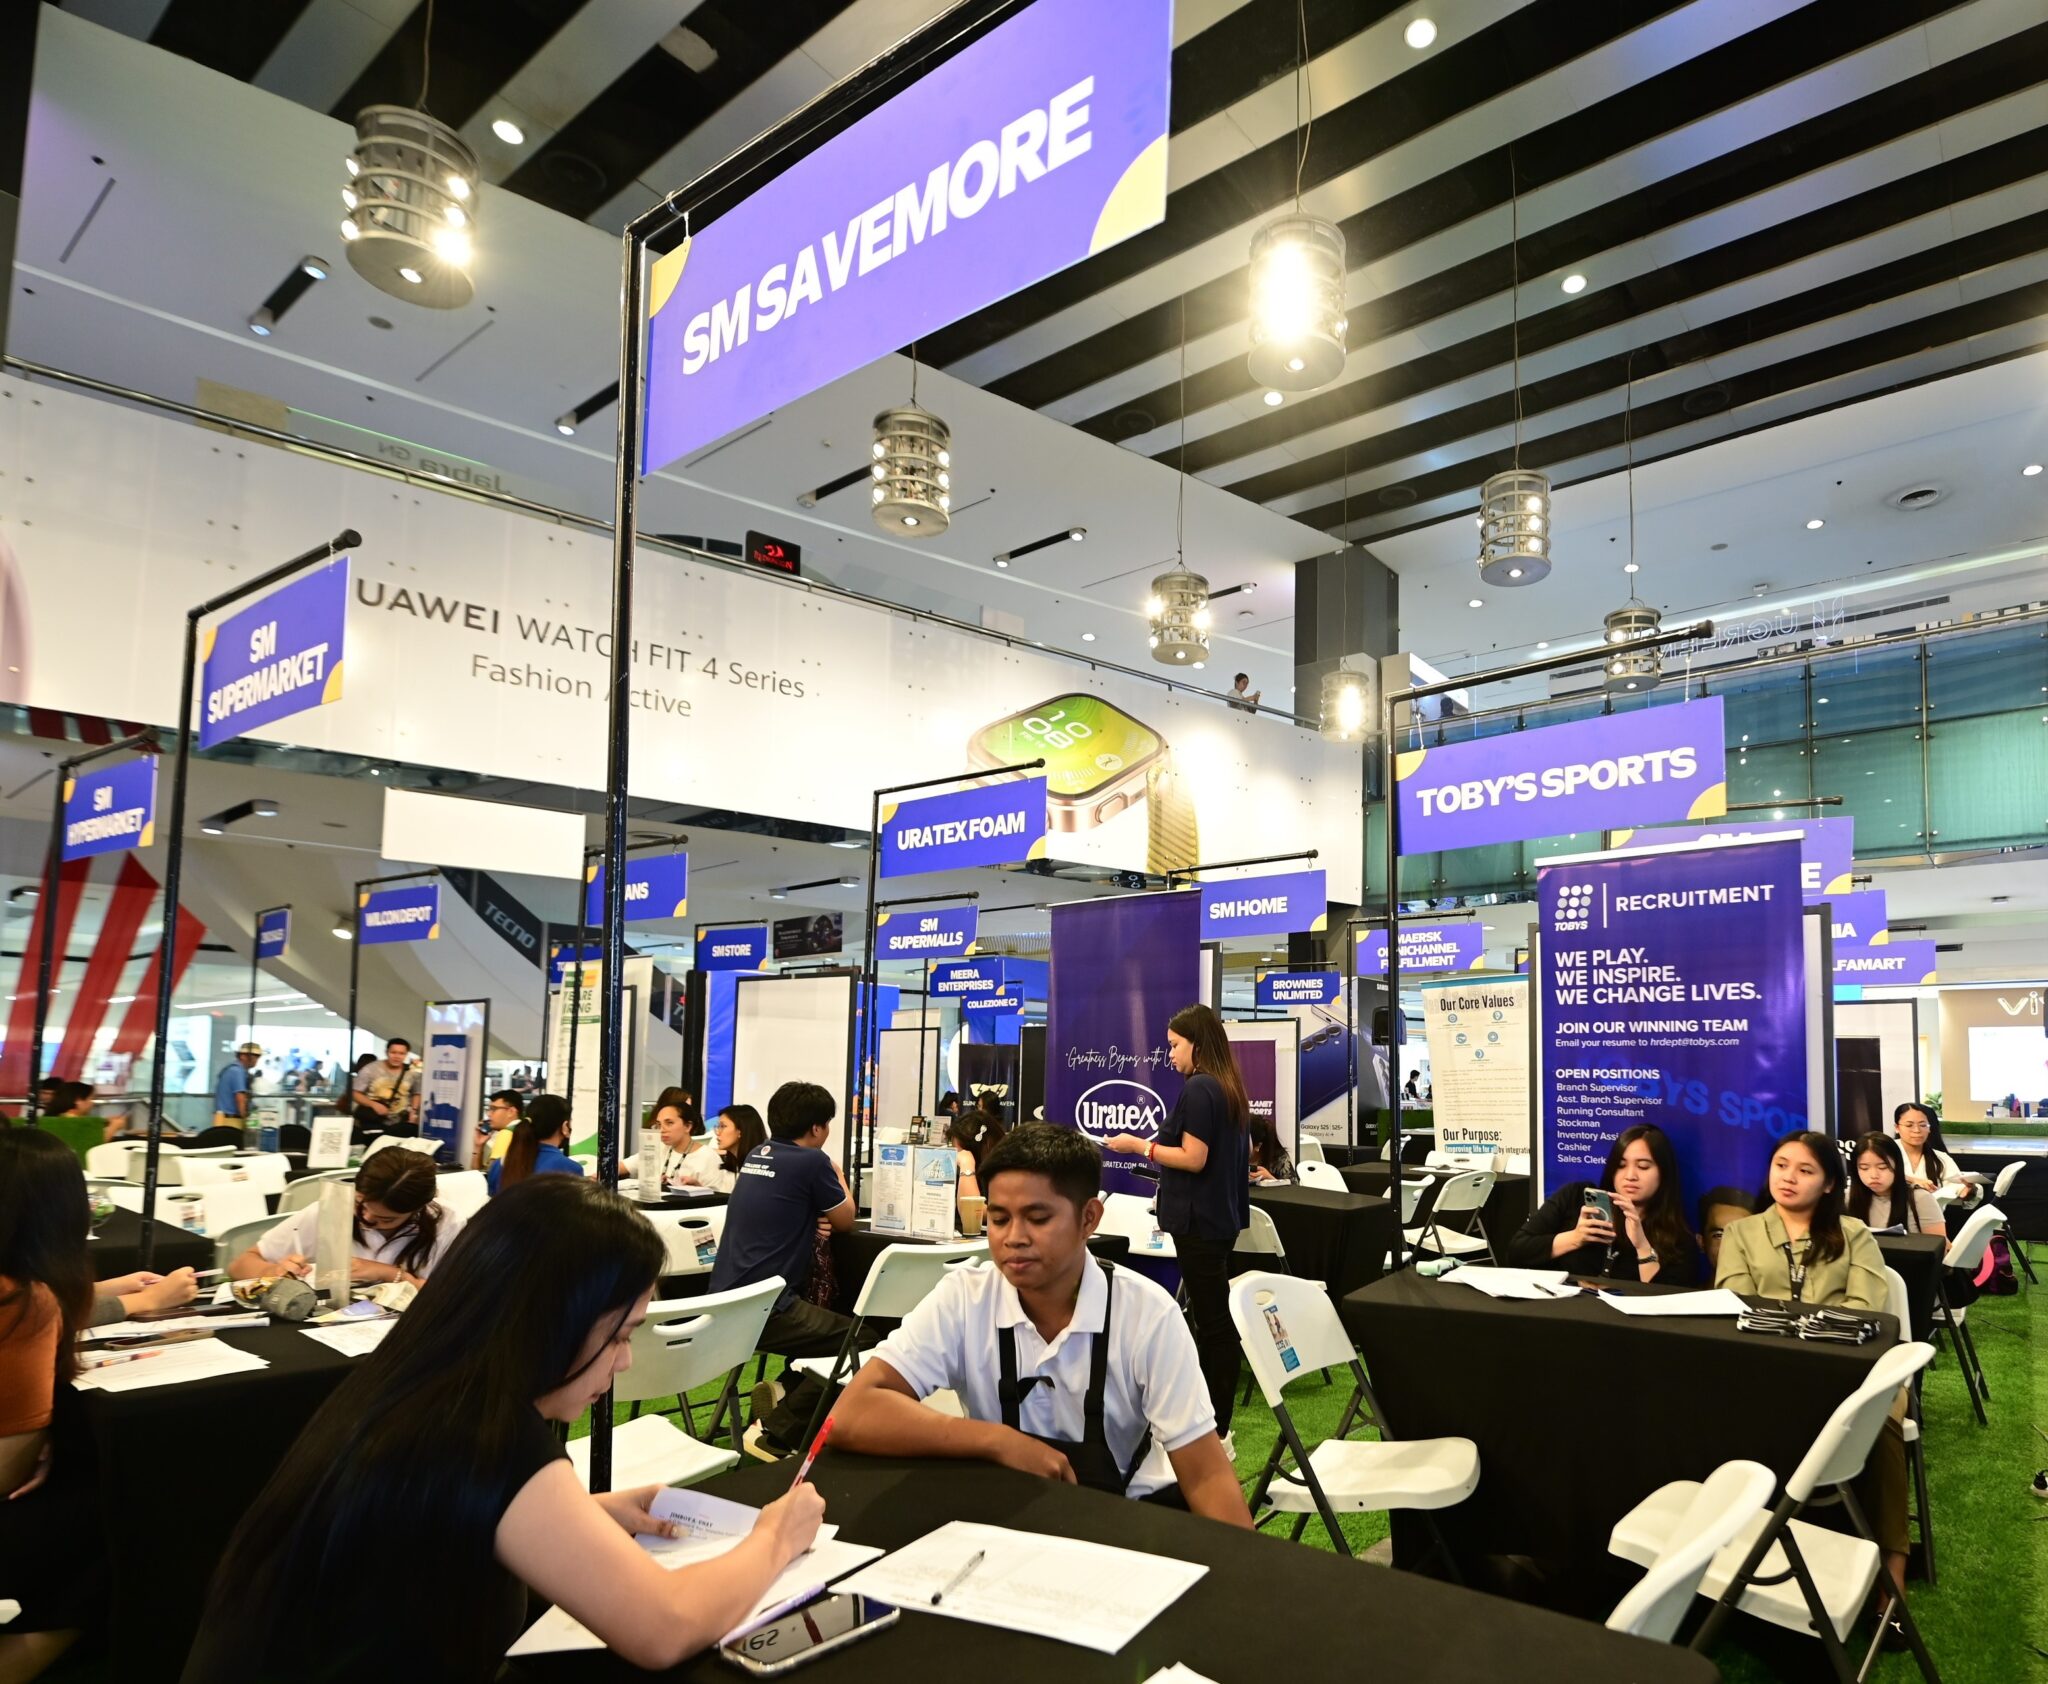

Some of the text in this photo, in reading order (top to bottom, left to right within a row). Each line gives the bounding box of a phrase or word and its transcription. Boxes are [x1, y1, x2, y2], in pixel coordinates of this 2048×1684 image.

[682, 75, 1095, 375] SM SAVEMORE
[250, 621, 277, 663] SM
[355, 577, 500, 635] UAWEI
[648, 643, 692, 673] FIT
[701, 656, 719, 680] 4
[729, 661, 805, 699] Series
[208, 642, 328, 724] SUPERMARKET
[471, 653, 592, 701] Fashion
[1416, 746, 1697, 816] TOBY'S SPORTS
[93, 786, 113, 811] SM
[897, 811, 1026, 850] URATEX FOAM
[1209, 896, 1288, 920] SM HOME
[1555, 884, 1775, 932] TOBYS RECRUITMENT
[484, 901, 536, 949] TECNO
[920, 917, 938, 932] SM
[889, 931, 963, 950] SUPERMALLS
[711, 943, 752, 958] SM STORE
[1555, 947, 1649, 968] WE PLAY.
[950, 968, 979, 980] MEERA
[1555, 965, 1681, 987] WE INSPIRE.
[938, 979, 993, 993] ENTERPRISES
[1272, 979, 1323, 990] BROWNIES
[1272, 989, 1323, 1000] UNLIMITED
[1555, 982, 1762, 1006] WE CHANGE LIVES.
[967, 998, 1007, 1009] COLLEZIONE
[1440, 995, 1514, 1011] Our Core Values
[1555, 1019, 1749, 1034] JOIN OUR WINNING TEAM
[1555, 1039, 1579, 1047] Email
[1581, 1040, 1600, 1048] your
[1650, 1038, 1740, 1048] hrdept@tobys.com
[1555, 1069, 1660, 1079] OPEN POSITIONS
[1556, 1083, 1638, 1093] Branch Supervisor
[1556, 1095, 1662, 1105] Asst. Branch Supervisor
[1556, 1107, 1644, 1117] Running Consultant
[1556, 1118, 1600, 1128] Stockman
[1443, 1127, 1502, 1143] Our Purpose:
[1557, 1131, 1598, 1141] Inventory
[1557, 1142, 1591, 1152] Cashier
[1557, 1154, 1607, 1164] Sales Clerk
